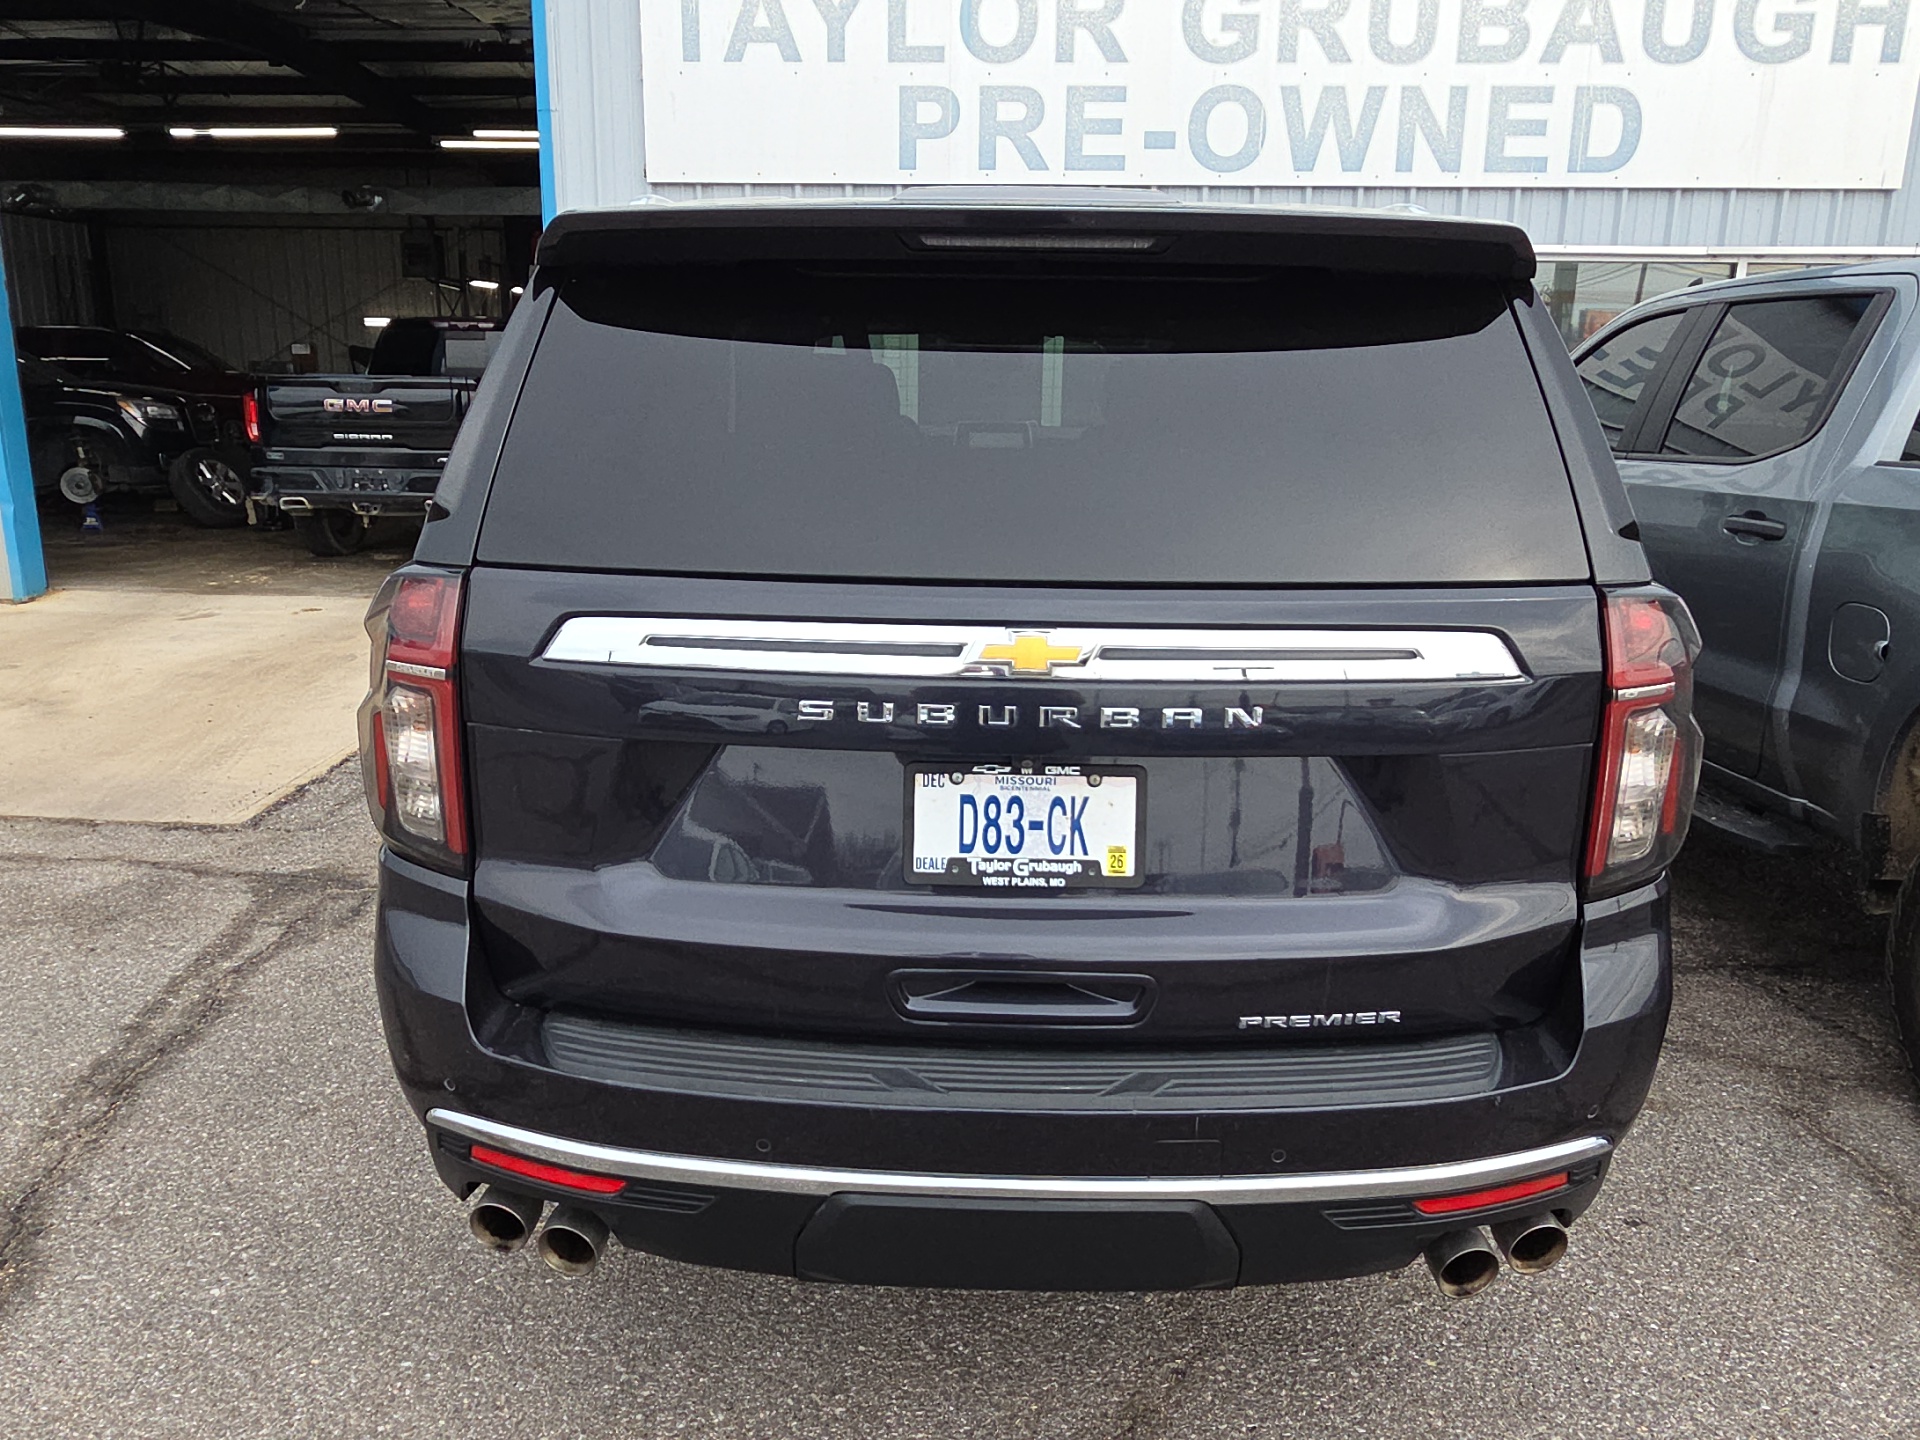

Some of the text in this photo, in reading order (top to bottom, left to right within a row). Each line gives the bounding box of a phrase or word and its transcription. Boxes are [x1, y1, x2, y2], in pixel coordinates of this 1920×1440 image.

[1180, 0, 1909, 65] GRUBAUGH
[898, 85, 1643, 174] PRE-OWNED
[323, 398, 393, 413] GMC
[797, 700, 1264, 729] SUBURBAN
[1045, 765, 1081, 776] GMC
[922, 773, 946, 788] DEC
[994, 776, 1057, 786] MISSOURI
[959, 794, 1090, 856] D83-CK
[915, 856, 947, 871] DEALE
[967, 857, 1082, 876] Taylor Grubaugh
[1110, 854, 1124, 869] 26
[982, 876, 1066, 888] WEST PLAINS, MO
[1238, 1010, 1401, 1029] PREMIER
